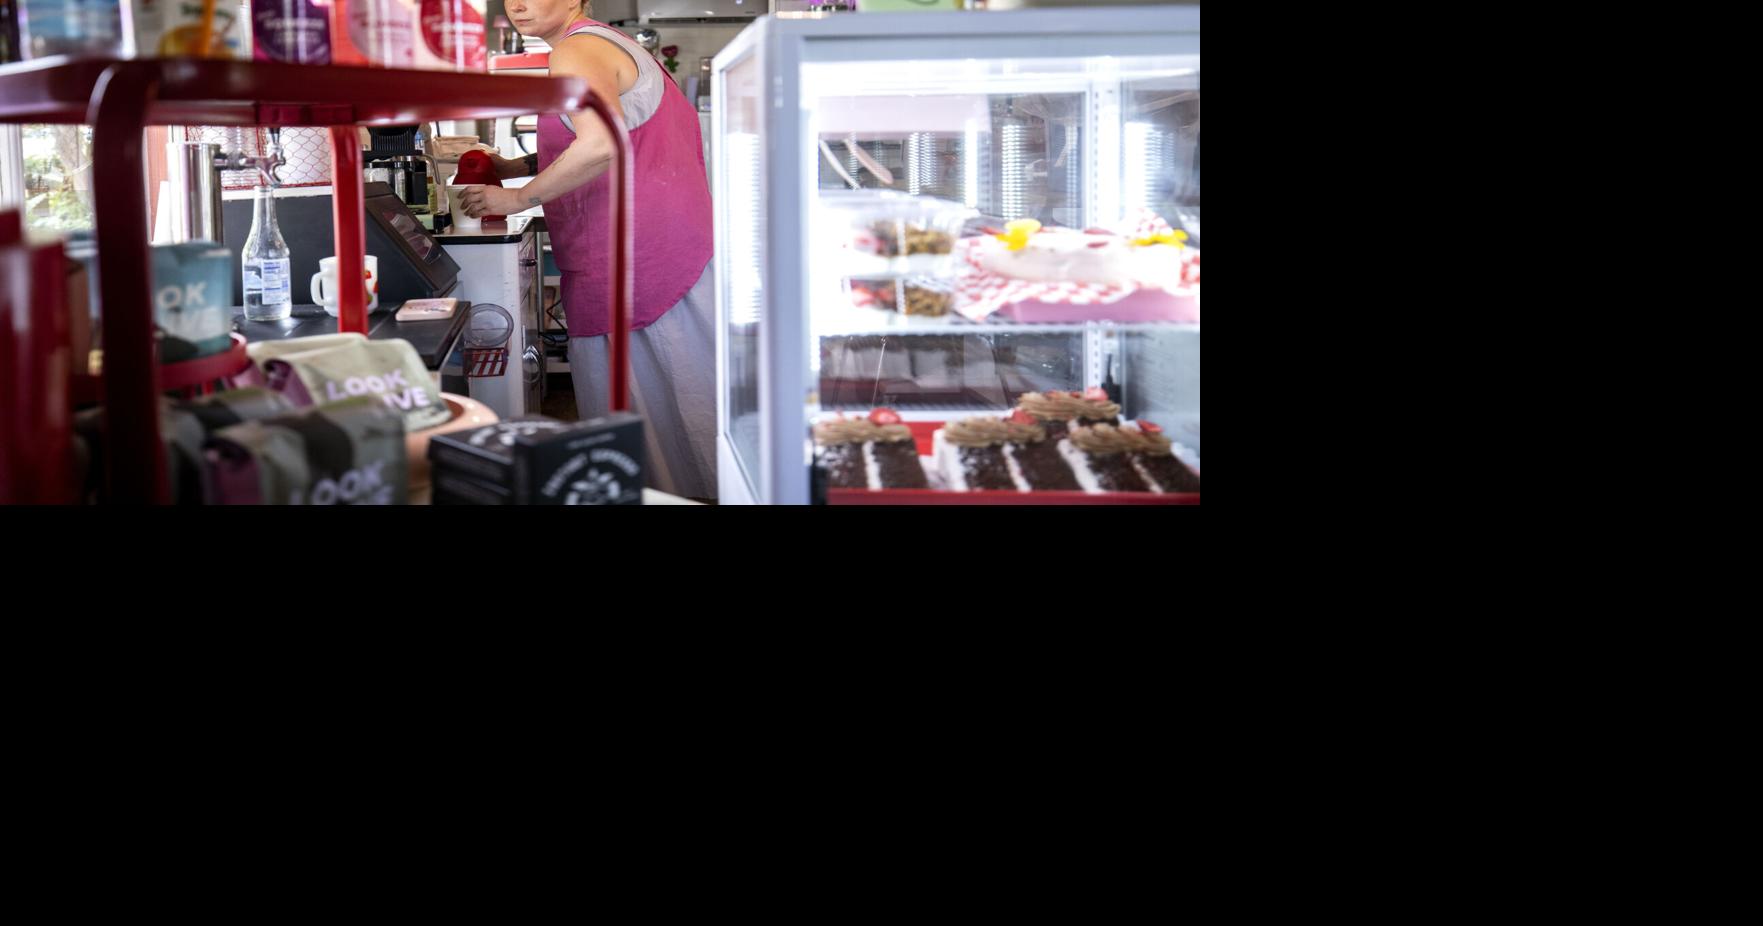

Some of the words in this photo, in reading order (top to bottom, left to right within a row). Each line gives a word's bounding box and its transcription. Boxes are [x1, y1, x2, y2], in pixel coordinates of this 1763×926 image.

[156, 280, 207, 309] OK
[325, 368, 408, 402] LOOK
[383, 386, 430, 410] IVE
